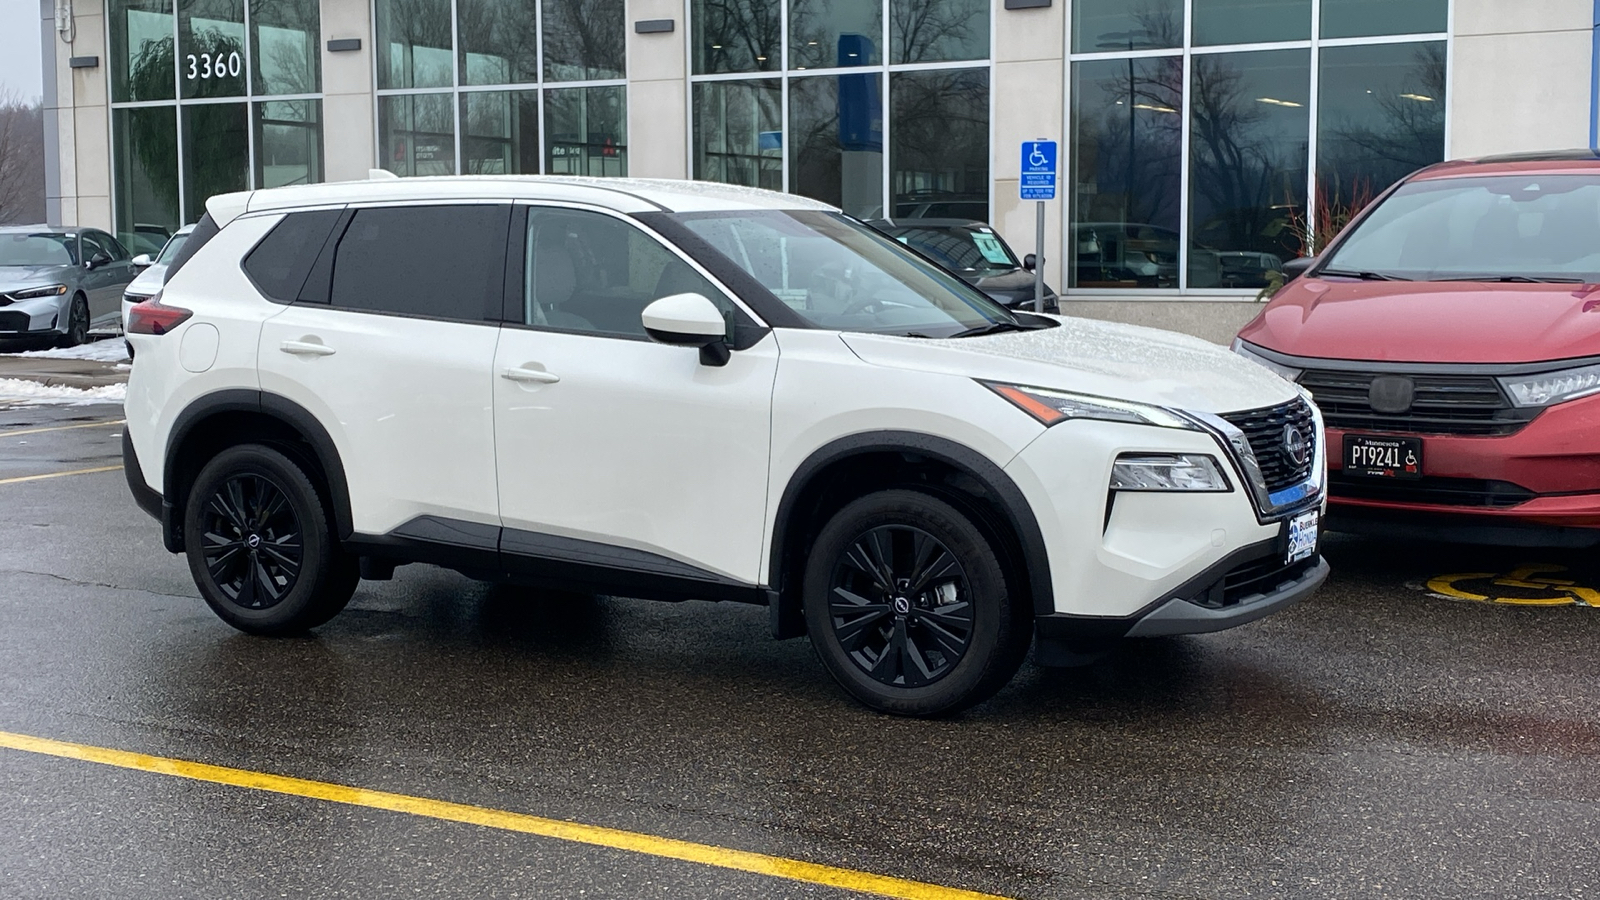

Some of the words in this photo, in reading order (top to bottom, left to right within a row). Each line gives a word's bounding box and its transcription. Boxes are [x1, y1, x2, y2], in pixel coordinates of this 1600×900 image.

[186, 52, 241, 80] 3360
[1364, 440, 1400, 448] Minnesota
[1352, 445, 1401, 467] PT9241
[1297, 529, 1317, 549] HONDA
